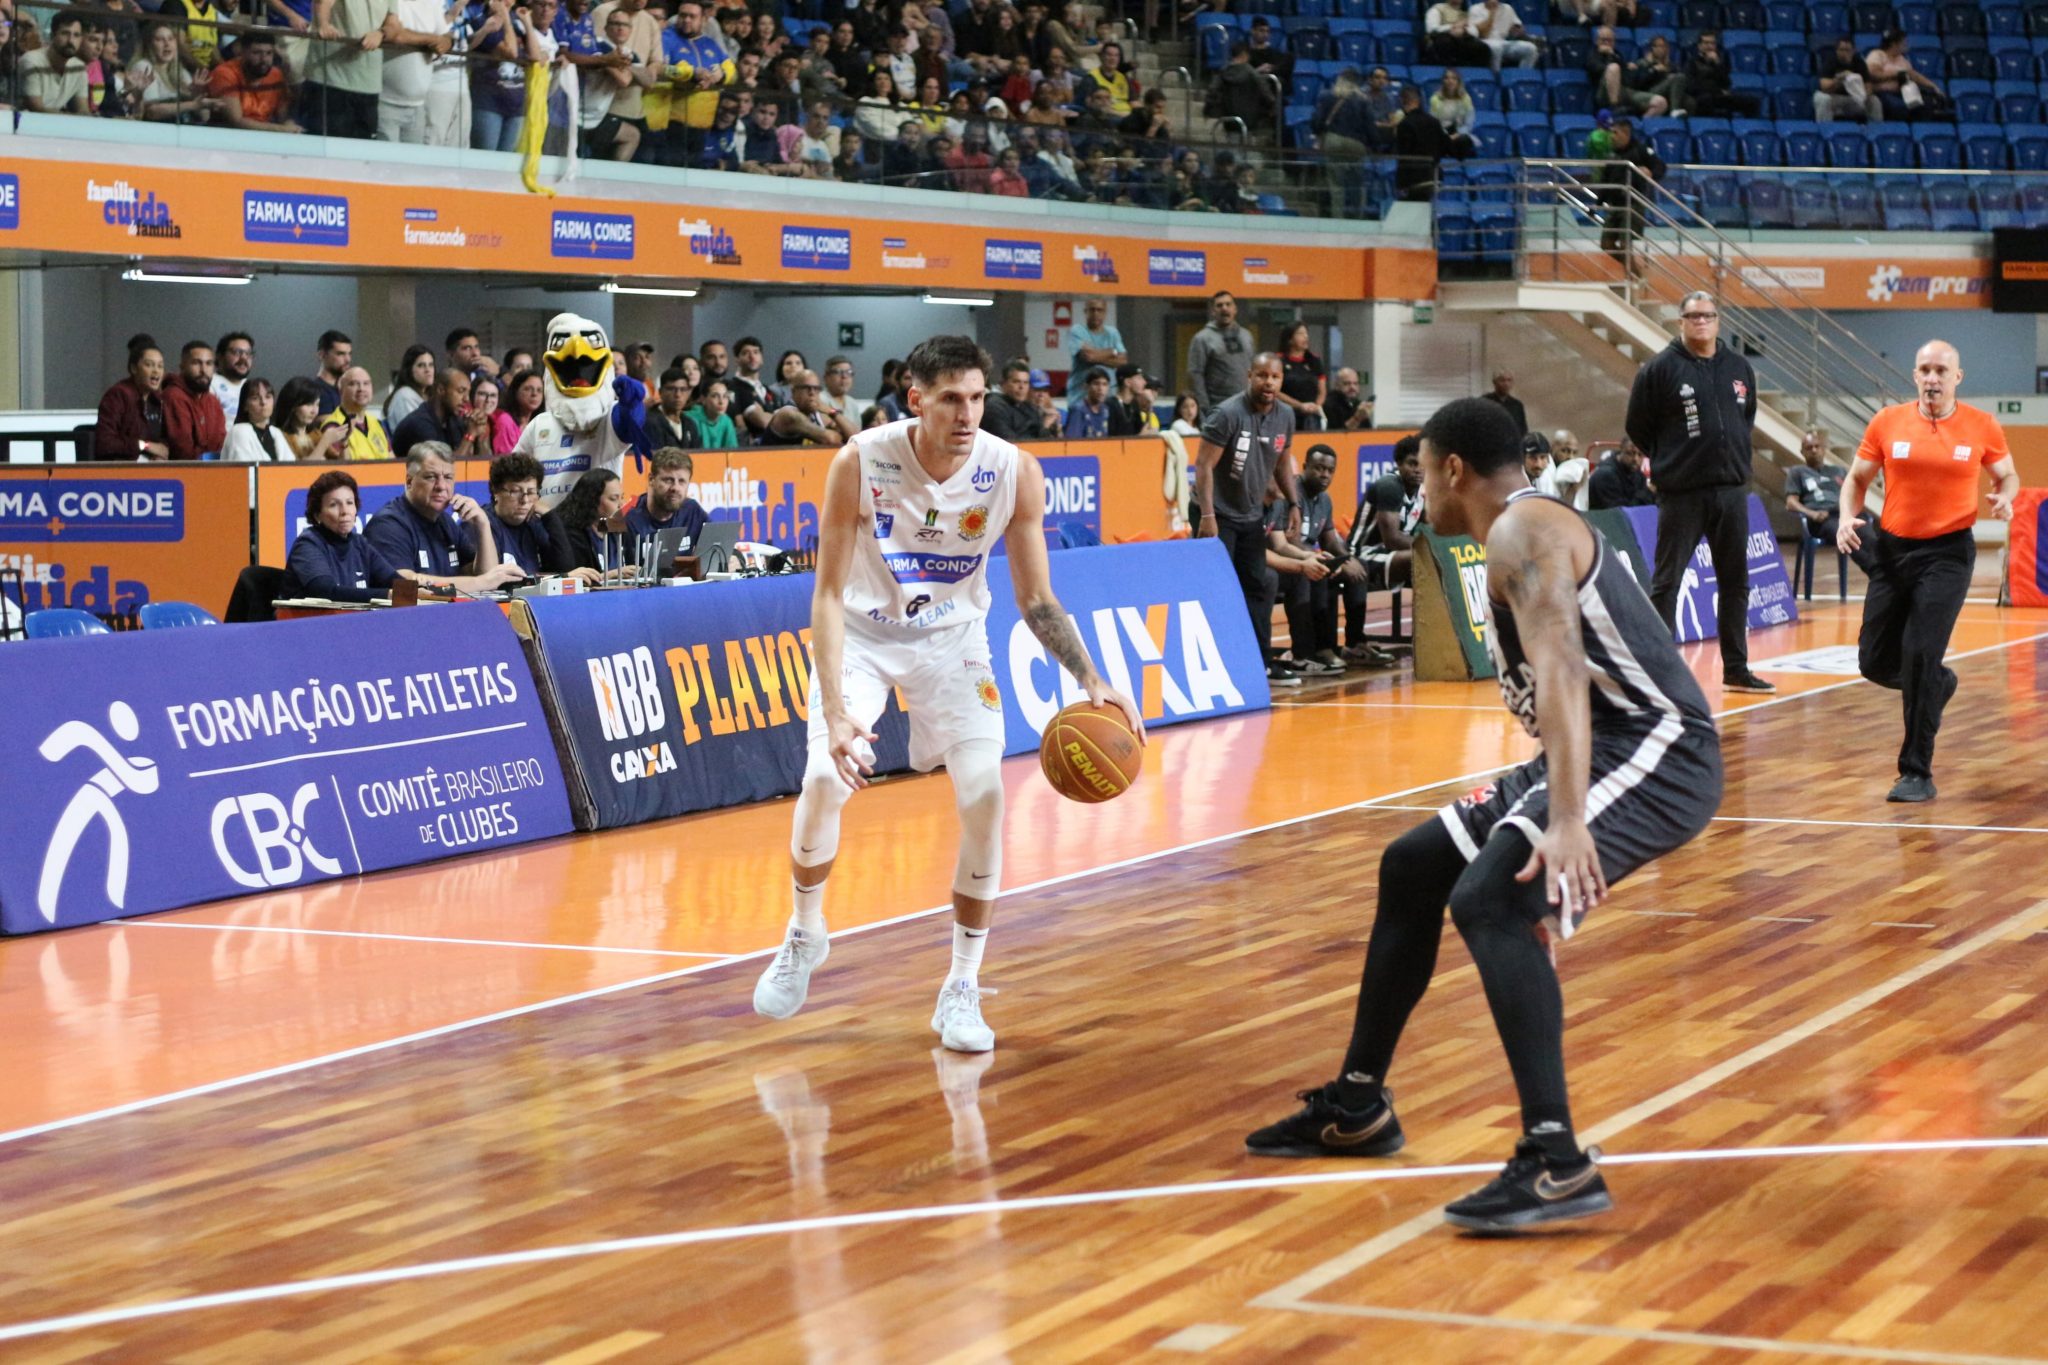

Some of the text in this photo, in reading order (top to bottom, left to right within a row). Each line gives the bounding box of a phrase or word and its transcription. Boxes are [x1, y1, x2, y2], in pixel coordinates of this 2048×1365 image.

[247, 200, 346, 227] FARMA CONDE
[554, 219, 632, 242] FARMA CONDE
[783, 233, 850, 254] FARMA CONDE
[58, 492, 174, 518] CONDE
[1044, 476, 1096, 514] ONDE
[167, 662, 518, 750] FORMAÇÃO DE ATLETAS
[586, 645, 665, 741] NBB
[664, 628, 812, 745] PLAYO
[610, 741, 678, 783] CAIXA
[1064, 741, 1121, 797] PENALTY
[358, 757, 544, 819] COMITÊ BRASILEIRO
[419, 802, 519, 848] DE CLUBES
